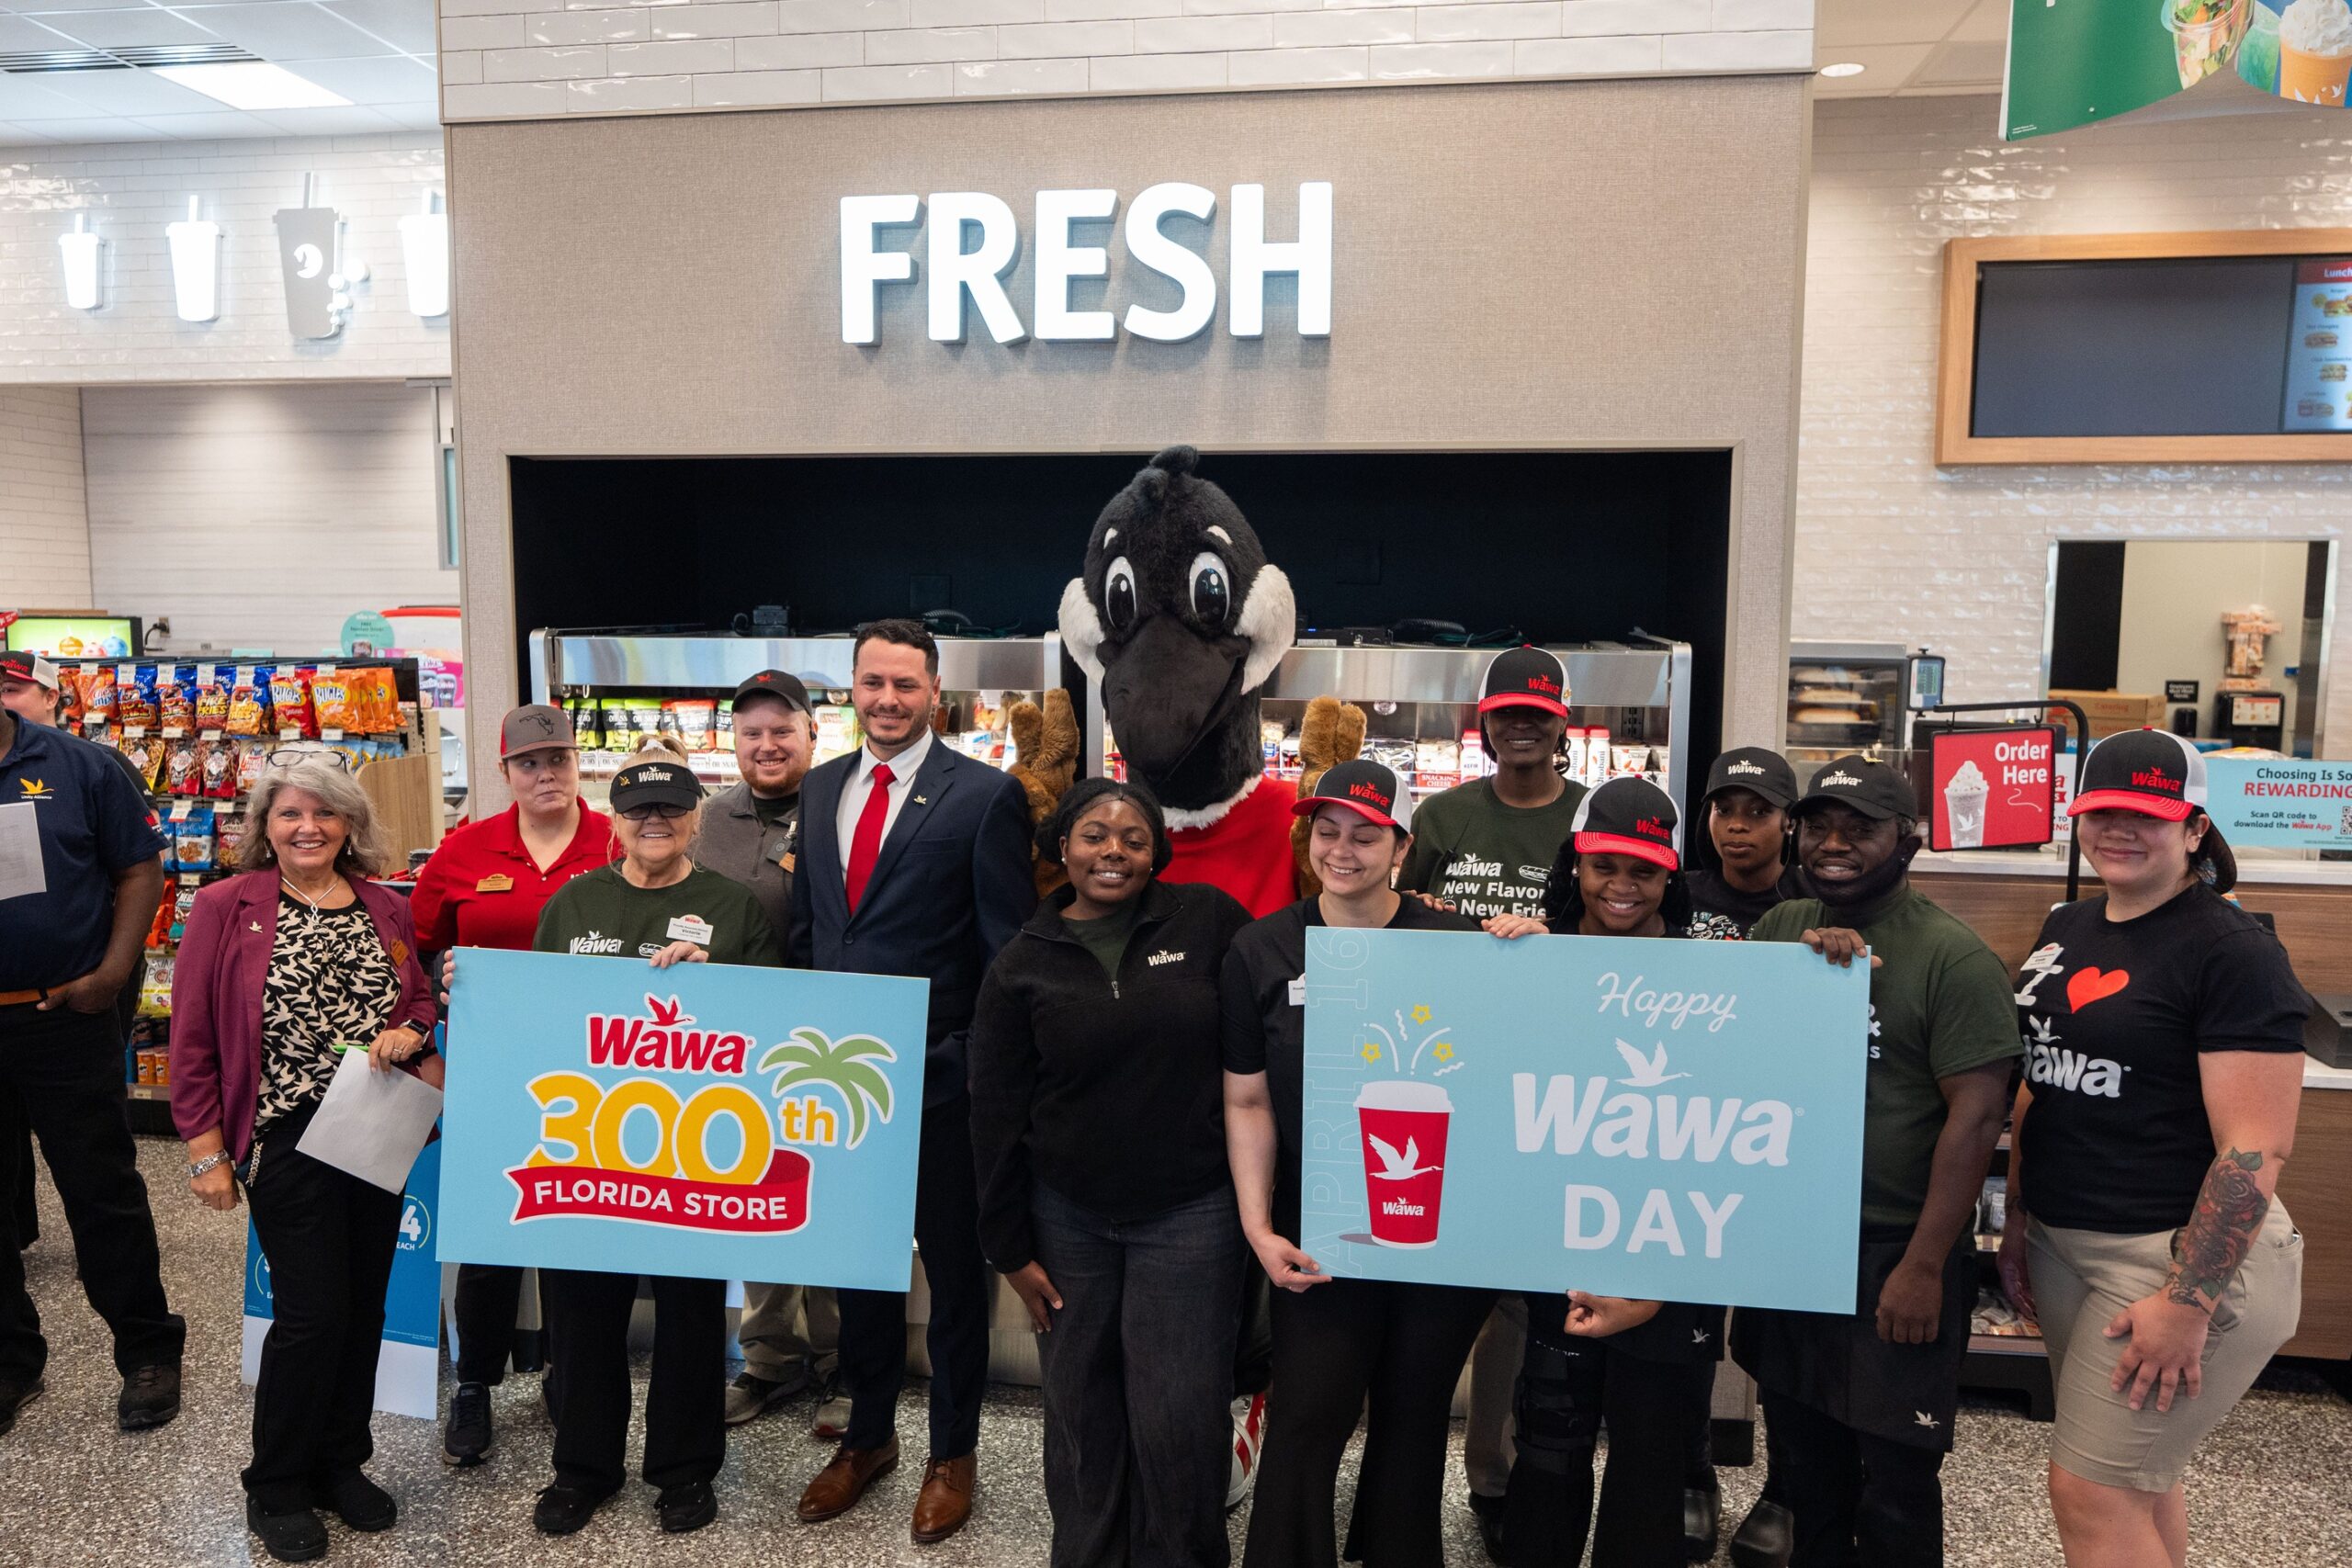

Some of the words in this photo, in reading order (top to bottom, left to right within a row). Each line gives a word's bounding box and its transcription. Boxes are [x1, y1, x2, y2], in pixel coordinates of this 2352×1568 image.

[840, 182, 1332, 345] FRESH
[315, 685, 346, 705] BUGLES
[1528, 678, 1560, 695] Wawa
[1994, 740, 2049, 762] Order
[1570, 750, 1578, 781] hobani
[1728, 764, 1762, 775] Wawa
[638, 771, 672, 783] Wawa
[1421, 773, 1457, 782] SNACKING
[1820, 775, 1859, 788] Wawa
[2002, 765, 2048, 786] Here
[2131, 772, 2181, 792] Wawa
[2256, 768, 2317, 783] Choosing
[2321, 770, 2333, 780] Is
[2337, 770, 2352, 781] So
[1350, 784, 1389, 807] Wawa
[2244, 782, 2352, 799] REWARDING
[2233, 819, 2274, 829] download
[2276, 821, 2289, 829] the
[2315, 823, 2333, 831] App
[2272, 811, 2285, 819] QR
[2287, 812, 2307, 820] code
[1636, 818, 1670, 840] Wawa
[1445, 862, 1502, 877] Wawa
[1442, 880, 1481, 896] New
[1460, 898, 1505, 917] New
[569, 936, 622, 953] Wawa
[1148, 951, 1184, 966] Wawa
[1307, 928, 1370, 1010] 16
[1596, 971, 1737, 1033] Happy
[588, 1015, 749, 1075] Wawa
[1512, 1072, 1793, 1168] Wawa
[1303, 1021, 1366, 1277] APRIL
[535, 1179, 673, 1213] FLORIDA
[684, 1193, 788, 1221] STORE
[1382, 1201, 1424, 1218] Wawa
[1563, 1183, 1744, 1259] DAY
[396, 1242, 415, 1251] EACH
